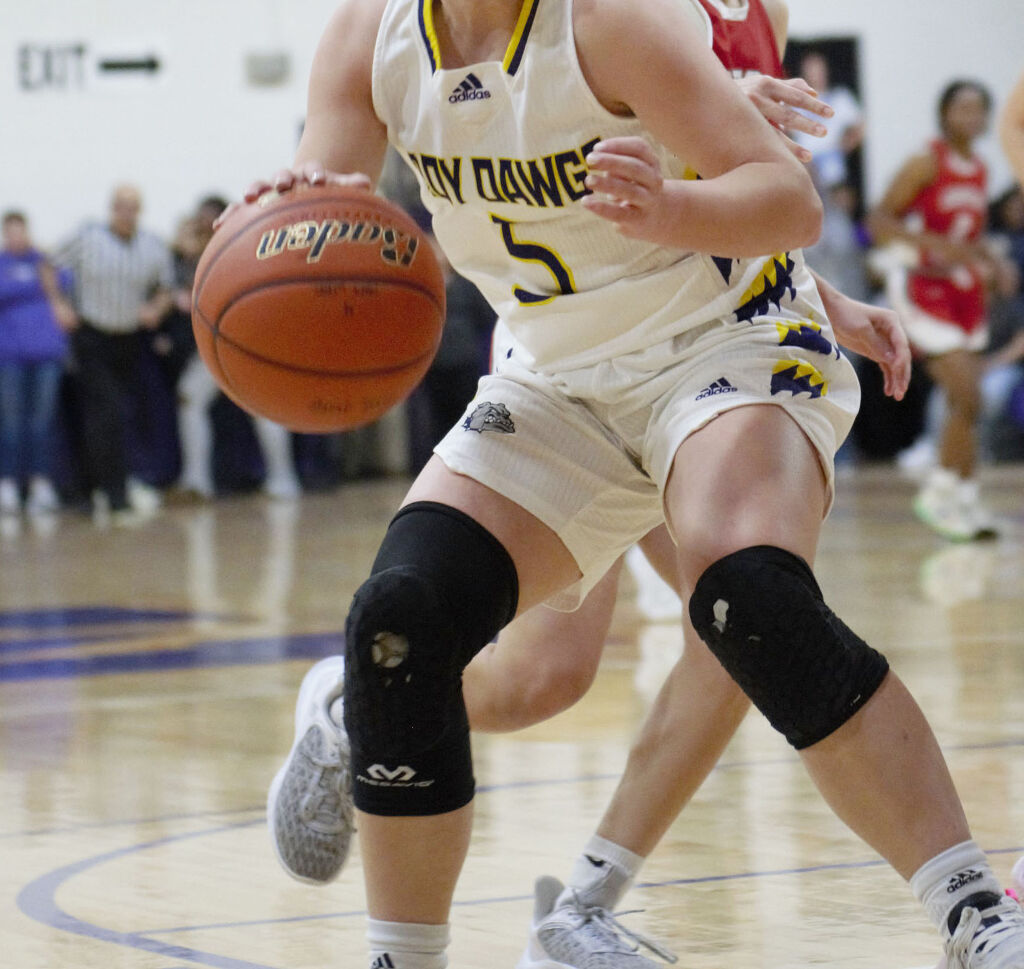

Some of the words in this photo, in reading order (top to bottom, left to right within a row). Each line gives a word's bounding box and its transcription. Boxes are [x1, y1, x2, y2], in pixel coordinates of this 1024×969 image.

[18, 42, 86, 91] EXIT
[448, 89, 491, 104] adidas
[257, 218, 419, 269] Baden
[487, 211, 577, 307] 5
[695, 385, 738, 401] adidas
[946, 871, 984, 893] adidas
